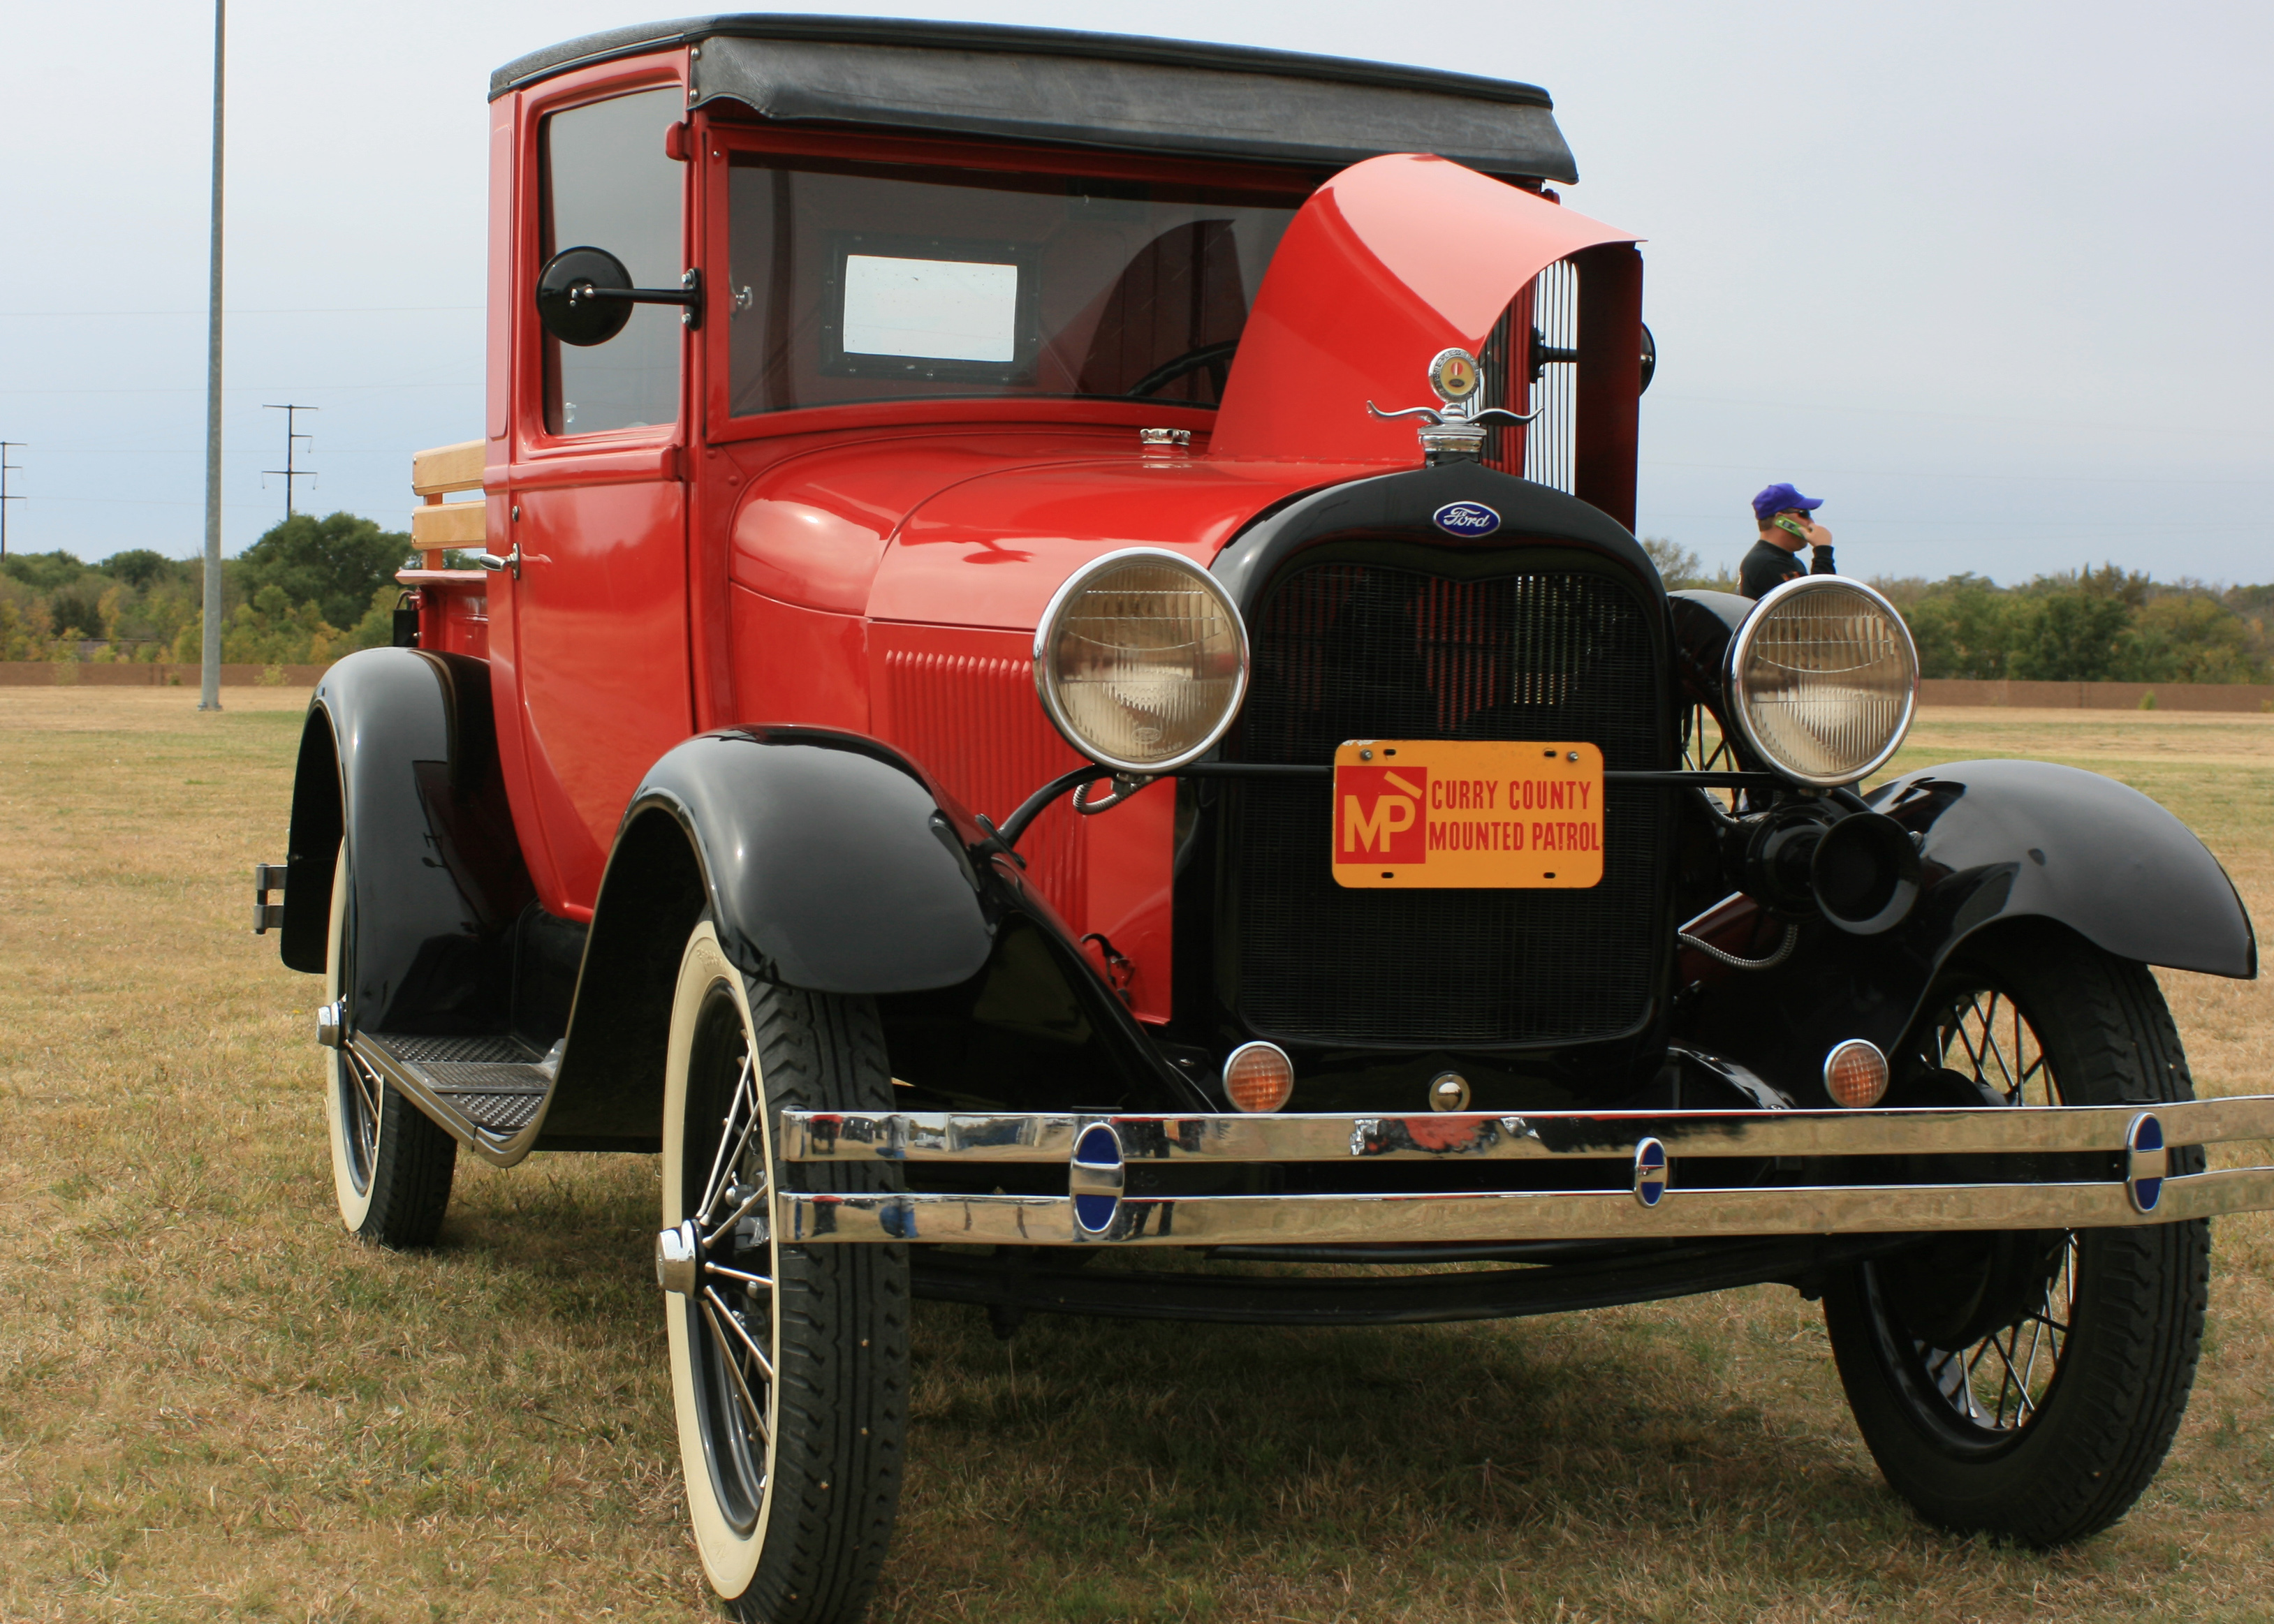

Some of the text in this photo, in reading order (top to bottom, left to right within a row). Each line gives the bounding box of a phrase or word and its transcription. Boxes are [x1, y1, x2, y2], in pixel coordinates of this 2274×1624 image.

[1443, 507, 1490, 527] Ford
[1432, 780, 1592, 810] CURRY COUNTY
[1429, 821, 1601, 851] MOUNTED PATROL
